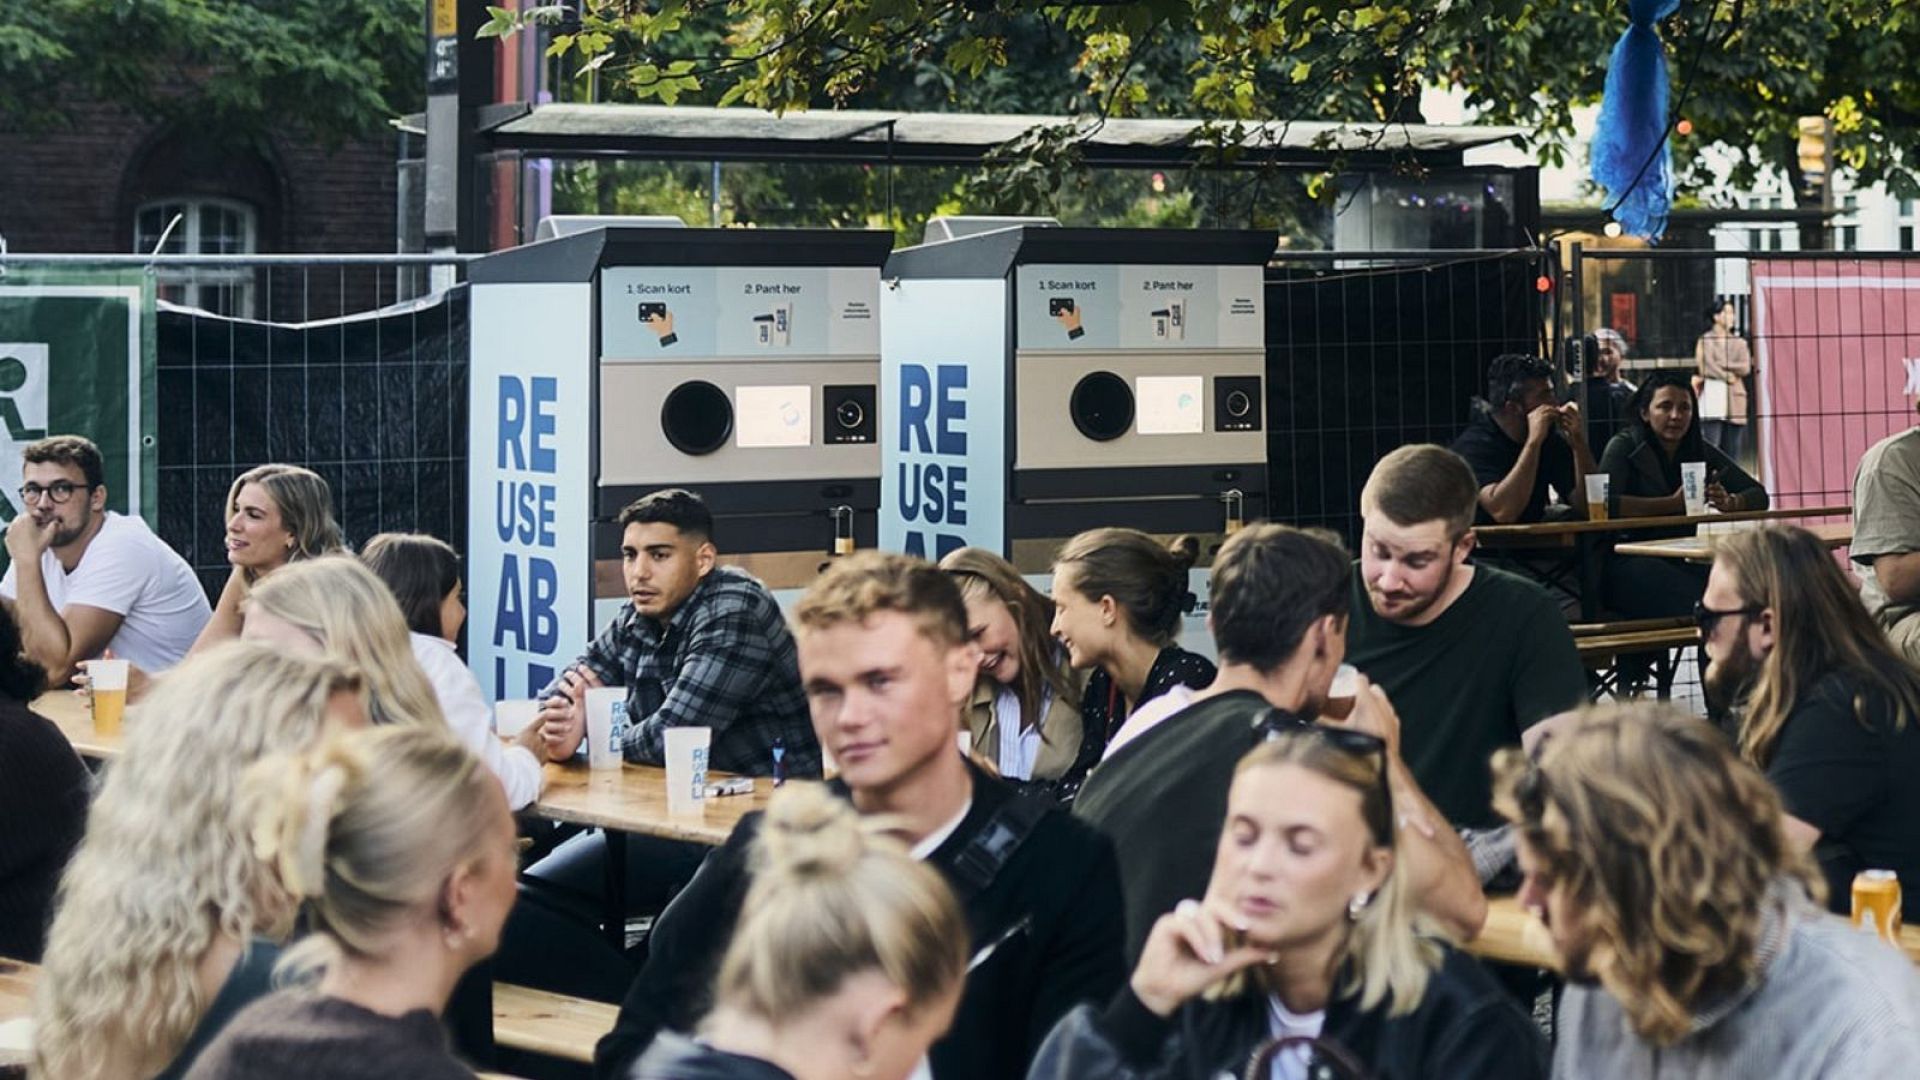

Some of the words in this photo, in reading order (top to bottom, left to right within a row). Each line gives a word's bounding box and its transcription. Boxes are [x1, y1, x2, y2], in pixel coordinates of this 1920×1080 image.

[636, 283, 666, 294] Scan
[667, 283, 690, 294] kort
[755, 283, 781, 294] Pant
[782, 283, 802, 294] her
[1047, 280, 1074, 291] Scan
[1074, 280, 1096, 291] kort
[1152, 280, 1176, 291] Pant
[1176, 280, 1194, 291] her
[497, 375, 557, 474] RE
[899, 364, 968, 456] RE
[497, 480, 556, 548] USE
[899, 462, 967, 526] USE
[493, 553, 559, 656] AB
